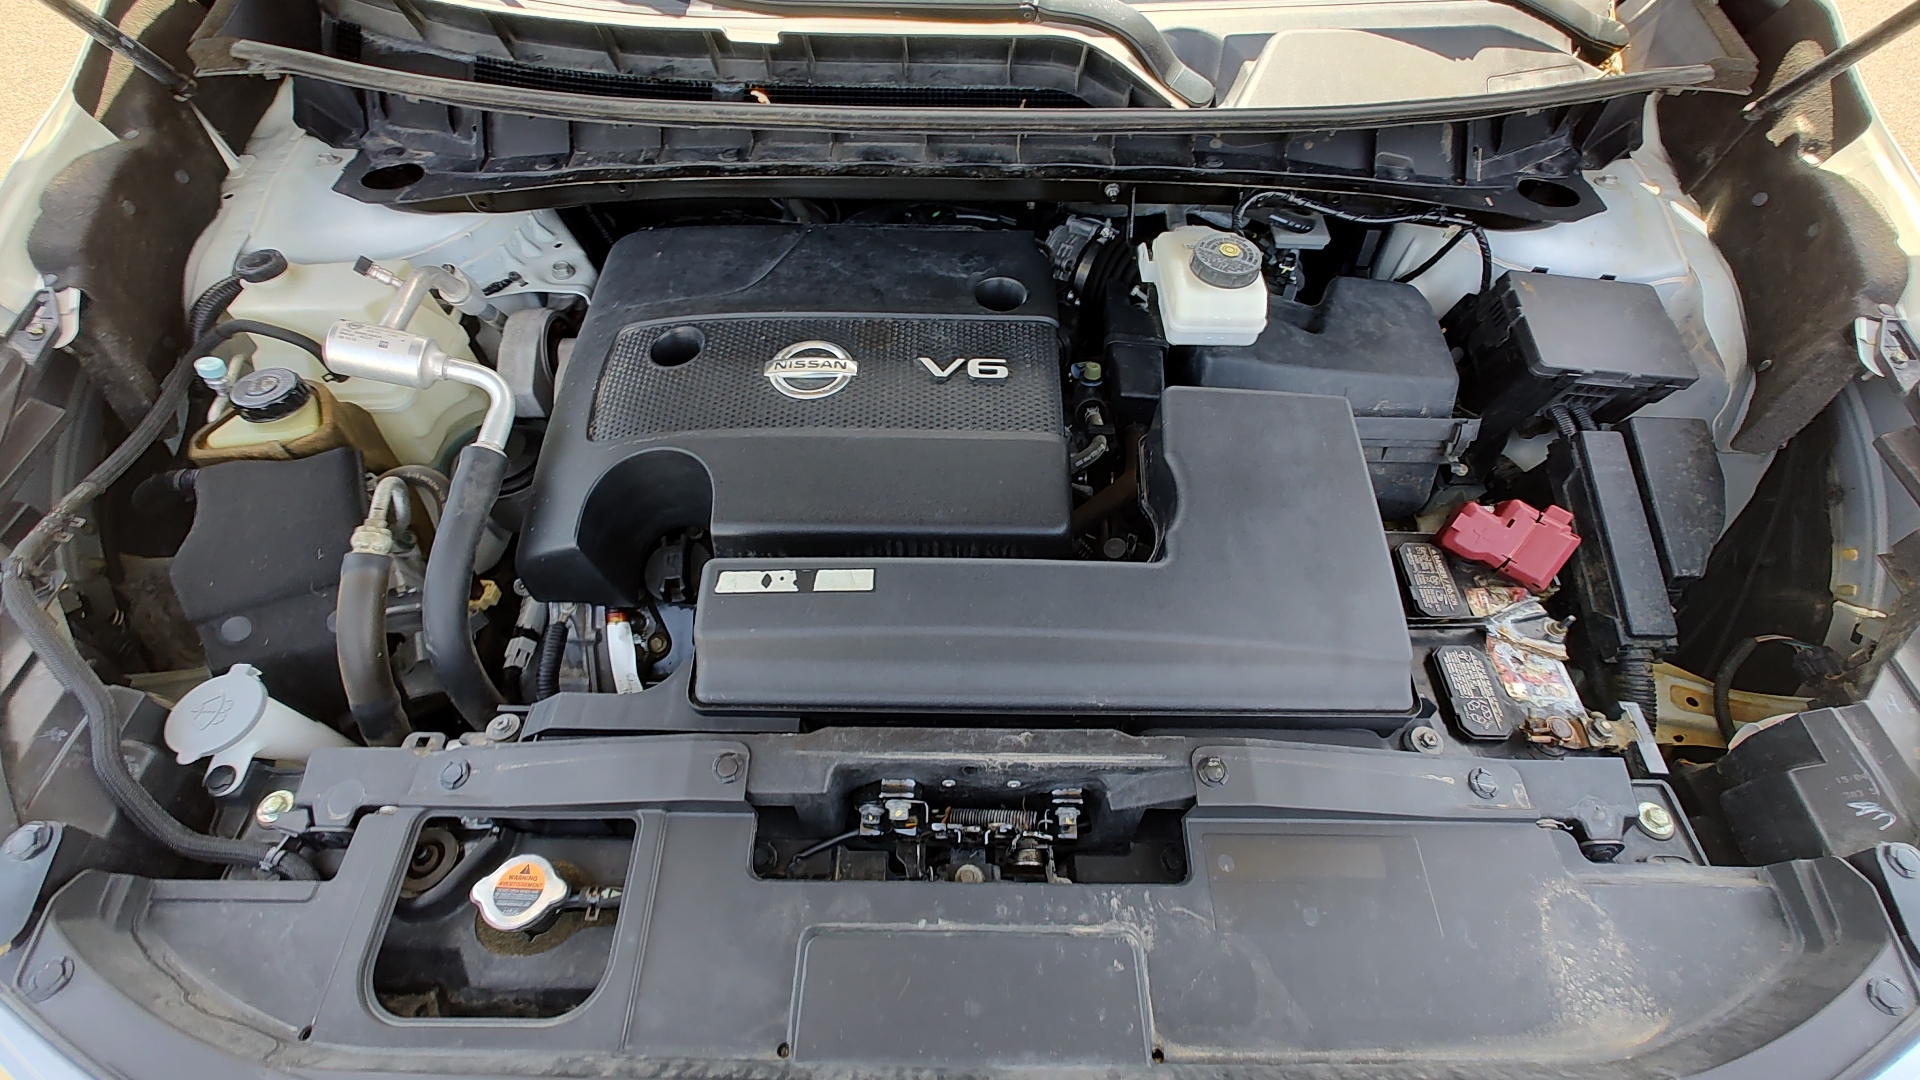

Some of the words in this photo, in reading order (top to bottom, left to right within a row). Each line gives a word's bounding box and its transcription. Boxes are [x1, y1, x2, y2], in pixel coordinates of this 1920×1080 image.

[774, 360, 848, 370] NISSAN
[919, 357, 1009, 379] V6
[1433, 554, 1448, 579] DANGER
[508, 874, 538, 882] WARNING
